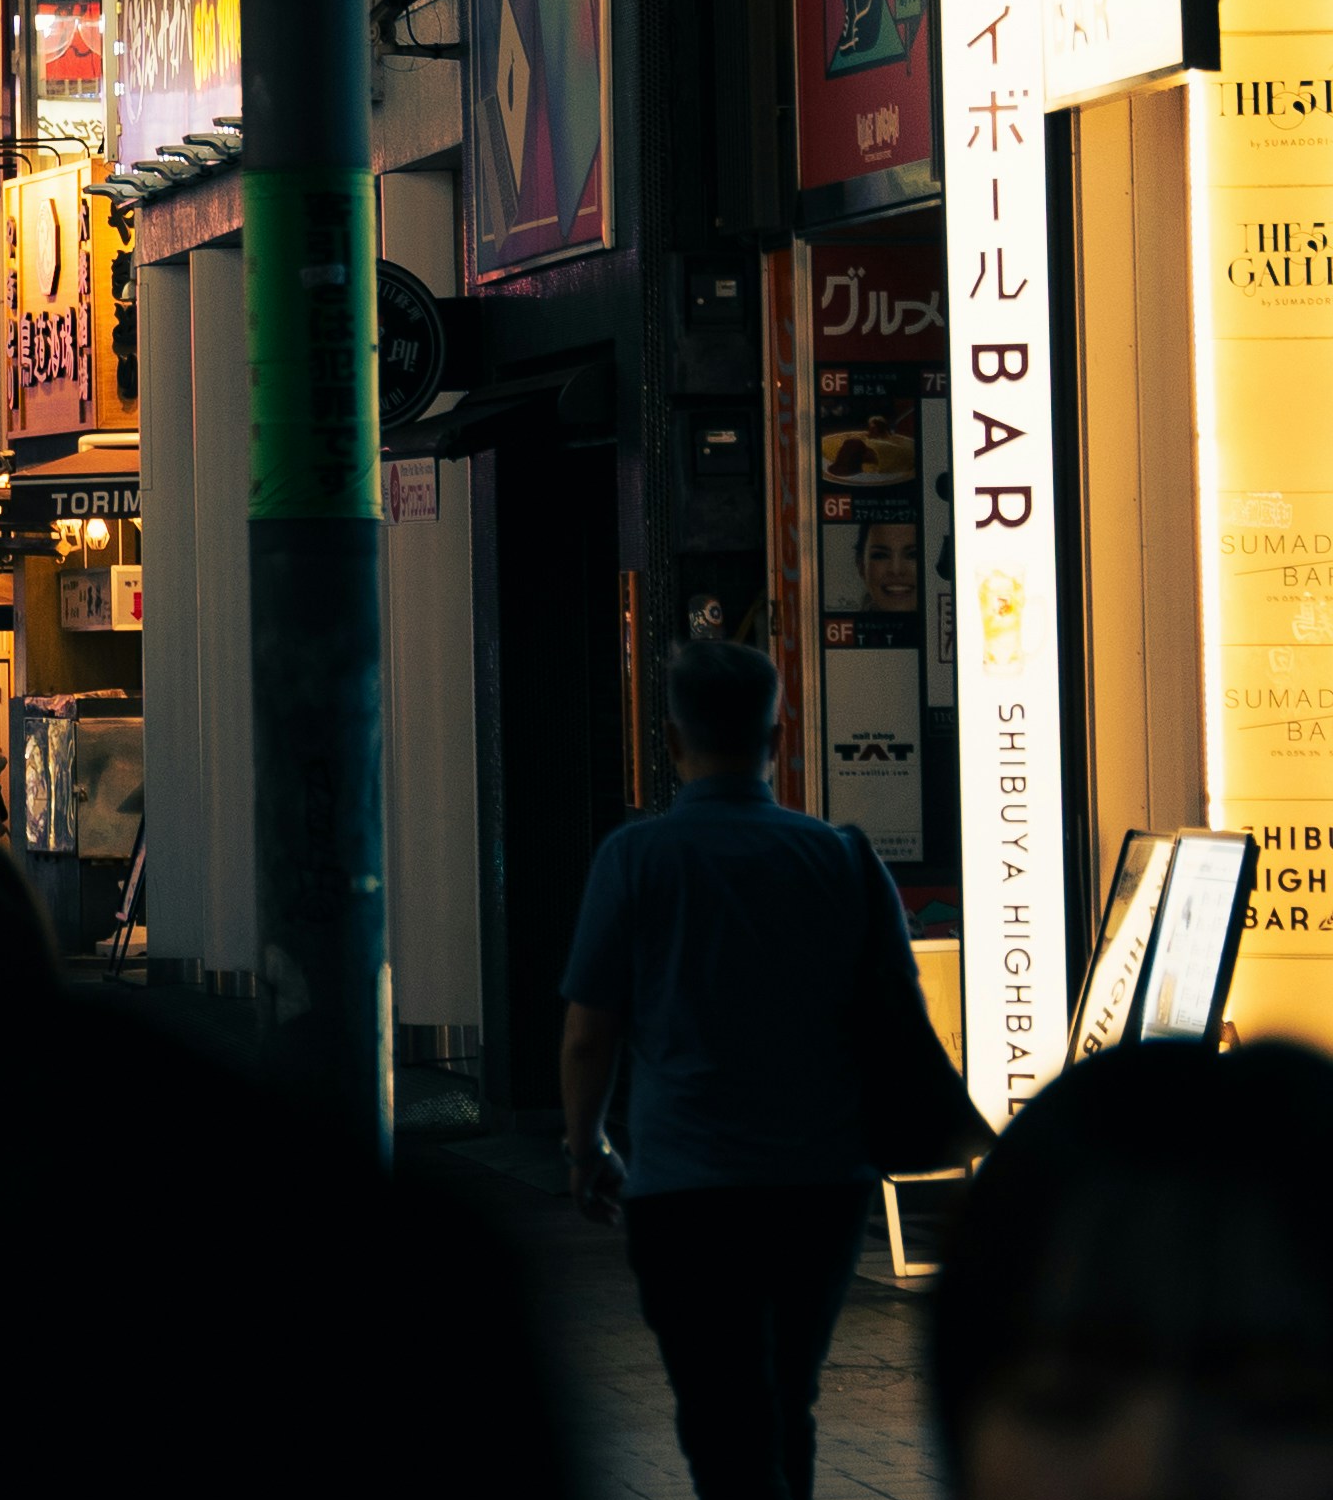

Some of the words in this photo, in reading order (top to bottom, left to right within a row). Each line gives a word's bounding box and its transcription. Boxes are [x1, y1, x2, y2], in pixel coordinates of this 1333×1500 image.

[1211, 79, 1287, 118] THE
[1236, 222, 1303, 254] THE
[821, 267, 944, 336] グルメ
[821, 373, 848, 394] 6F
[970, 342, 1034, 532] BAR
[823, 497, 852, 518] 6F
[826, 622, 854, 643] 6F
[835, 744, 915, 761] TAT
[873, 731, 895, 742] shop
[997, 703, 1032, 885] SHIBUYA
[1002, 904, 1038, 1116] HIGHBALL
